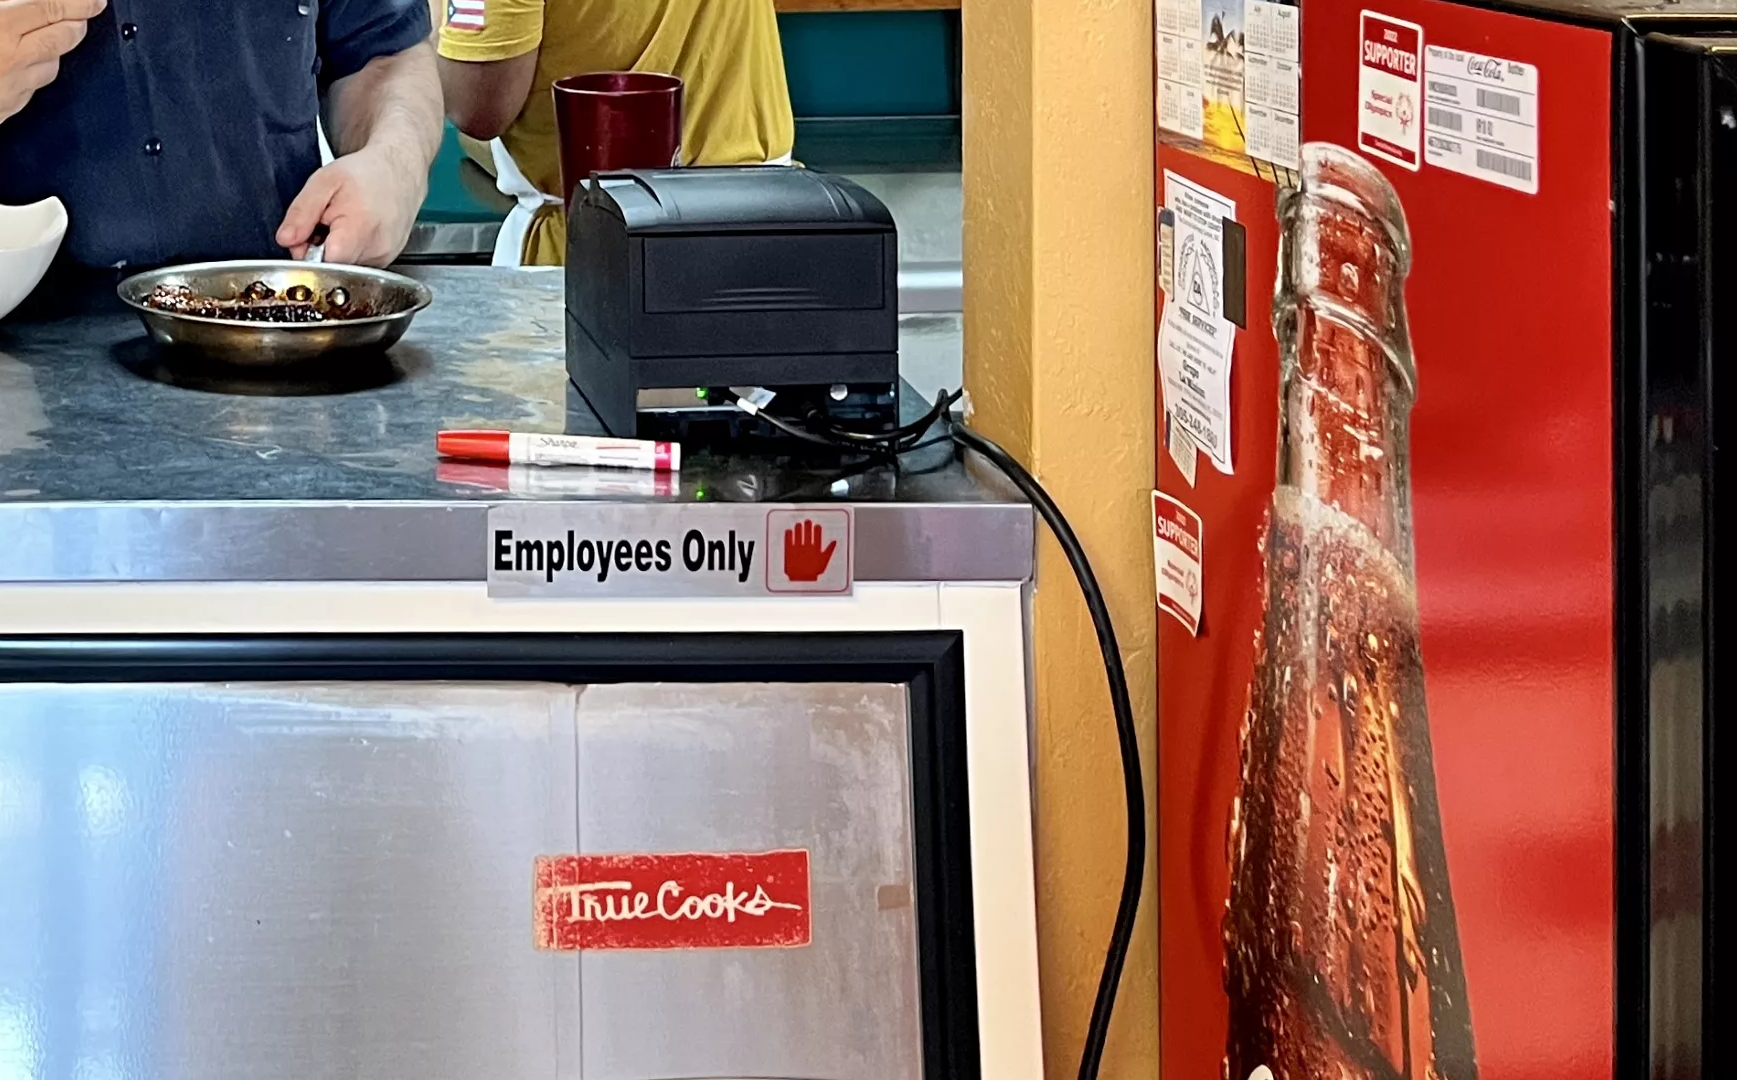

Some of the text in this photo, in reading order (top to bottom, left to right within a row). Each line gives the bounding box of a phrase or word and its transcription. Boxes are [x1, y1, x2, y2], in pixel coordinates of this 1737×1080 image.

[1364, 40, 1416, 76] SUPPORTER
[494, 530, 756, 583] Employees Only
